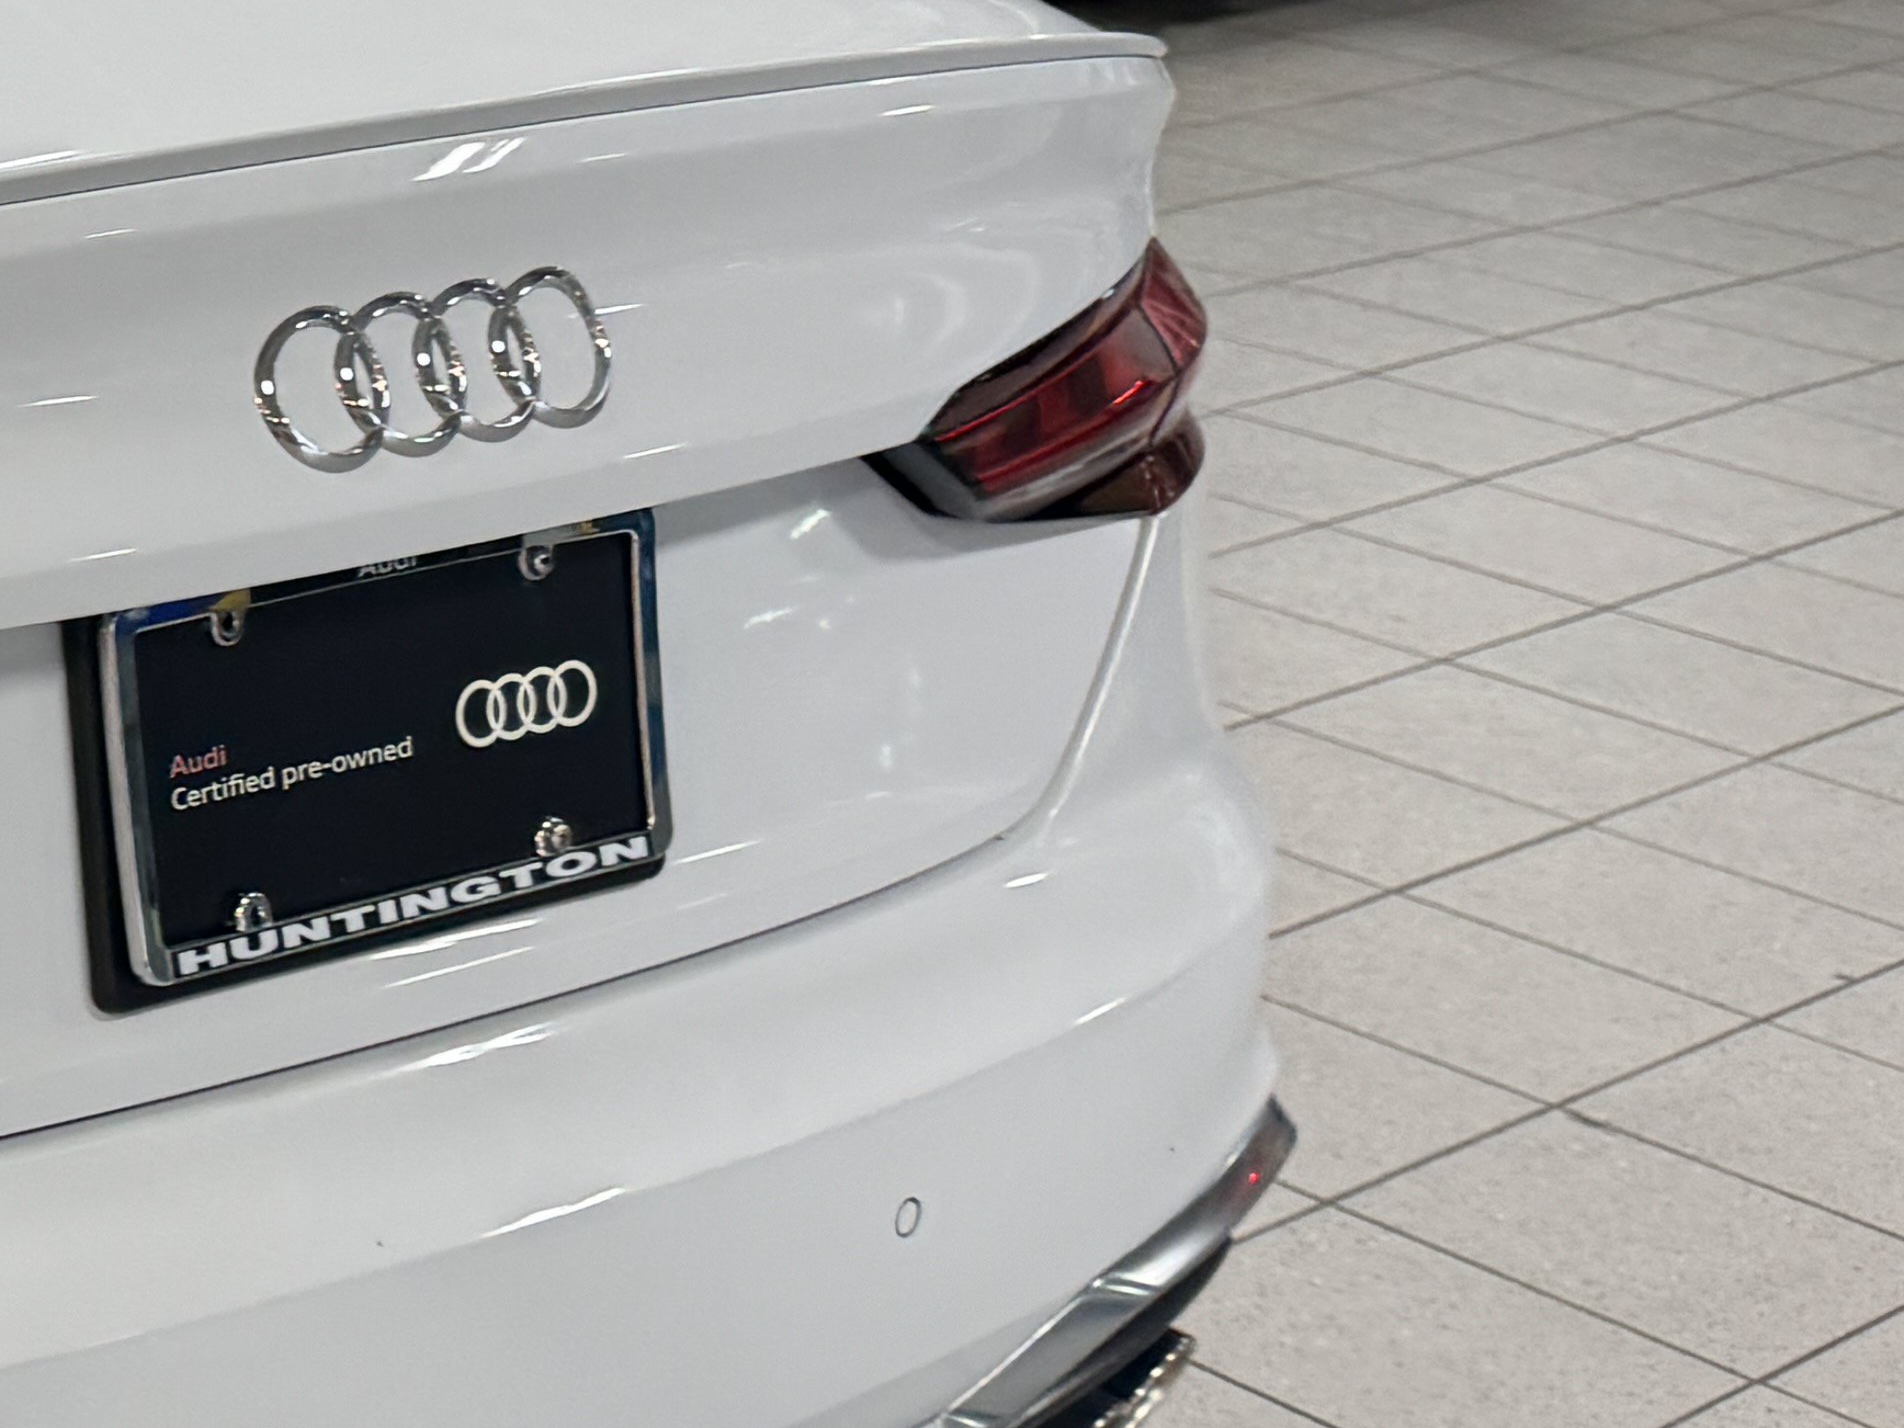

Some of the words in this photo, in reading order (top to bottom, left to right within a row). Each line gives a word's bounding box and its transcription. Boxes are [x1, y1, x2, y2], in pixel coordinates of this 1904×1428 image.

[169, 744, 228, 779] Audi
[170, 766, 276, 811] Certified
[281, 735, 414, 791] pre-owned
[176, 835, 649, 977] HUNTINGTON
